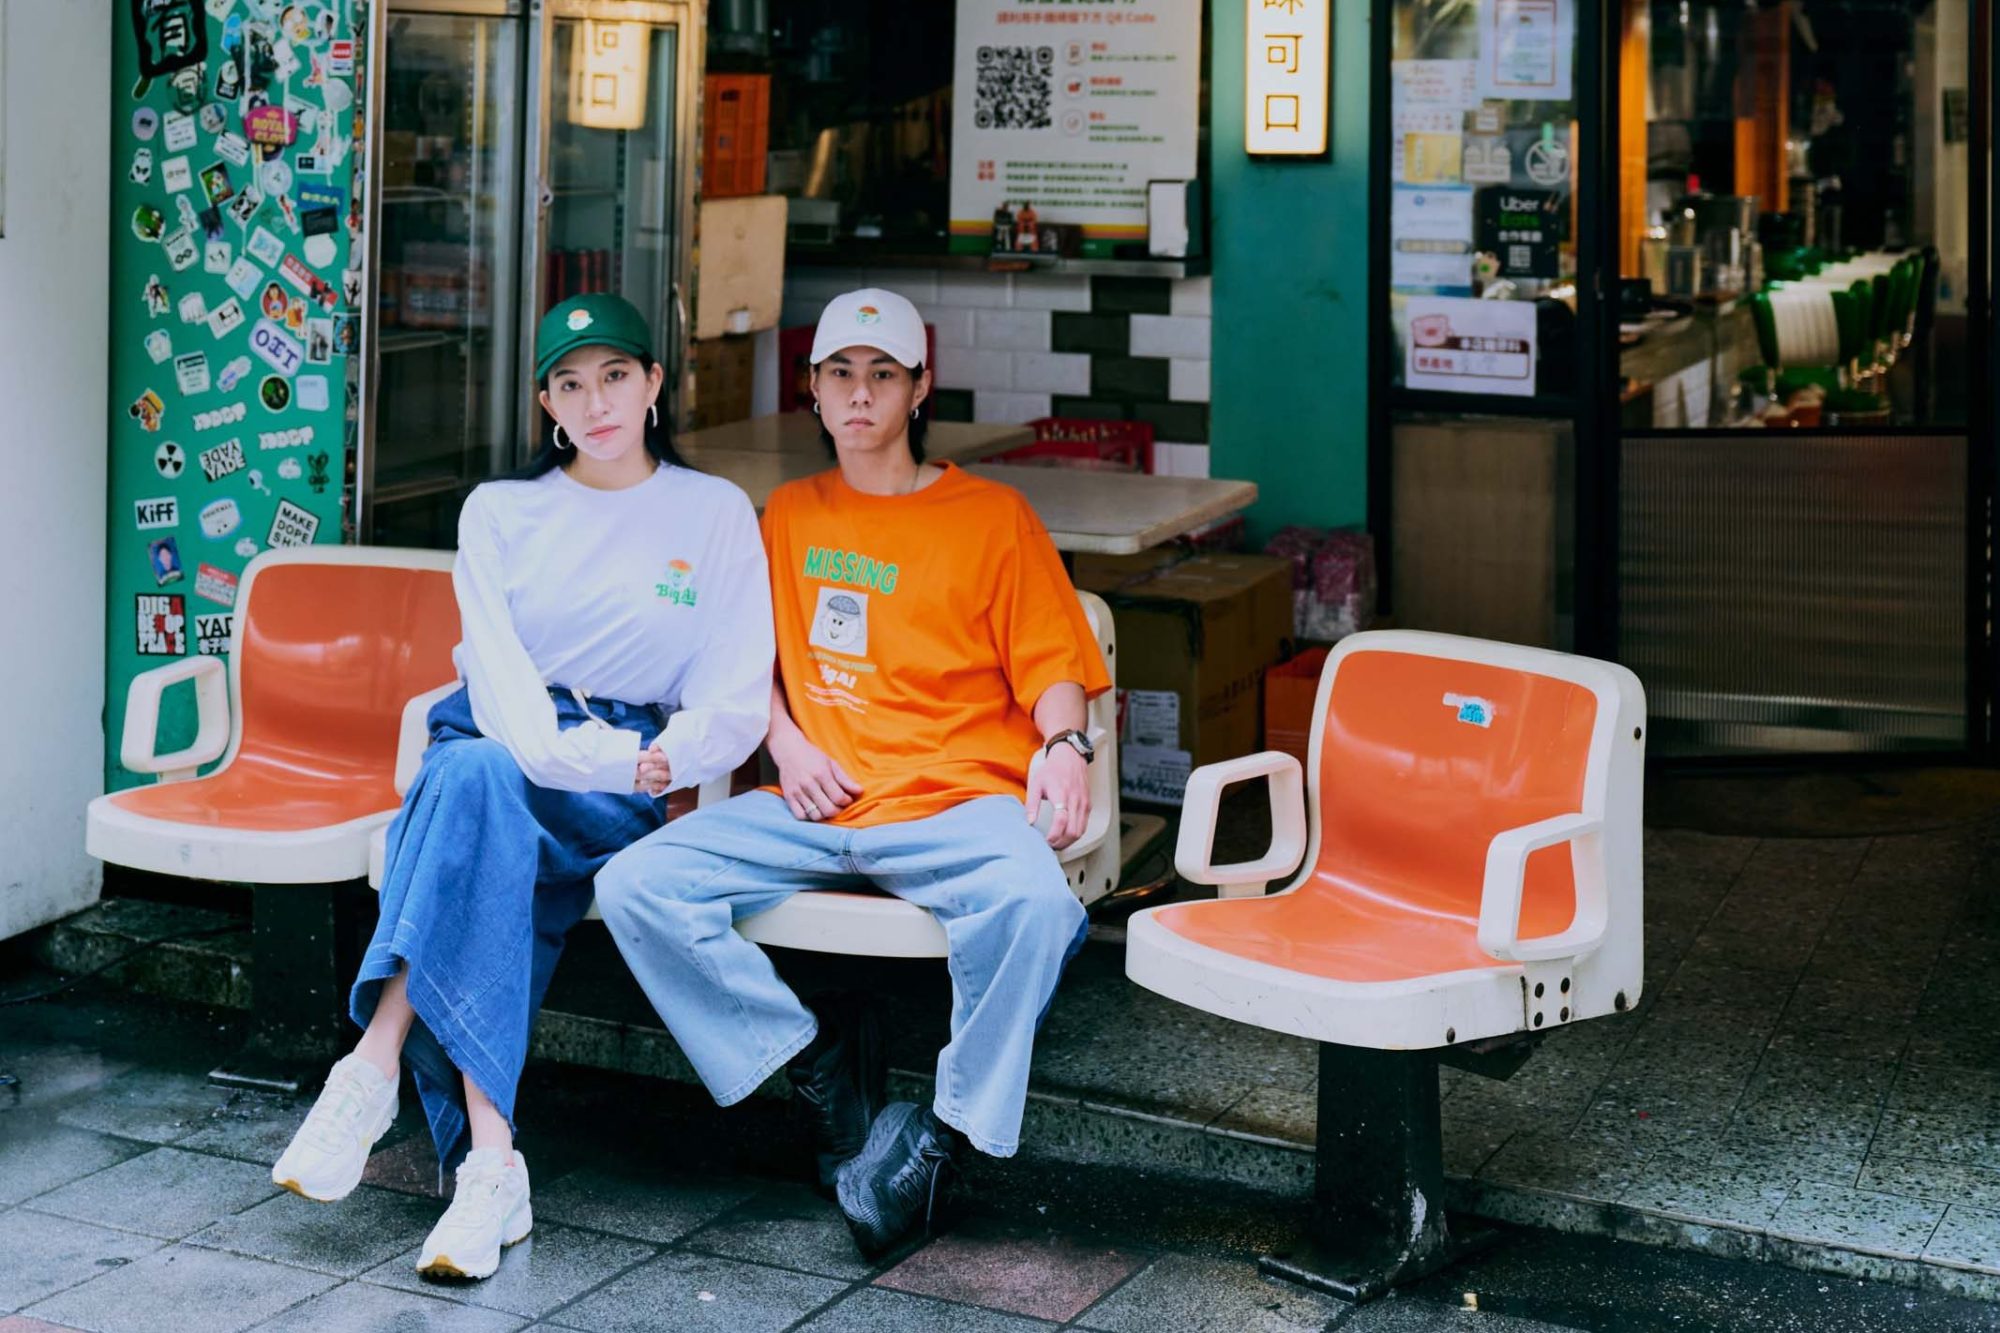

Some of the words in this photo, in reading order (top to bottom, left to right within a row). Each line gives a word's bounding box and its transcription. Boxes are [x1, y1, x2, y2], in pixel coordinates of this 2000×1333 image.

[1500, 197, 1539, 212] Uber
[1500, 213, 1539, 226] Eats
[282, 507, 313, 530] MAKE
[277, 520, 309, 543] DOPE
[803, 546, 899, 595] MISSING
[656, 583, 680, 606] Big
